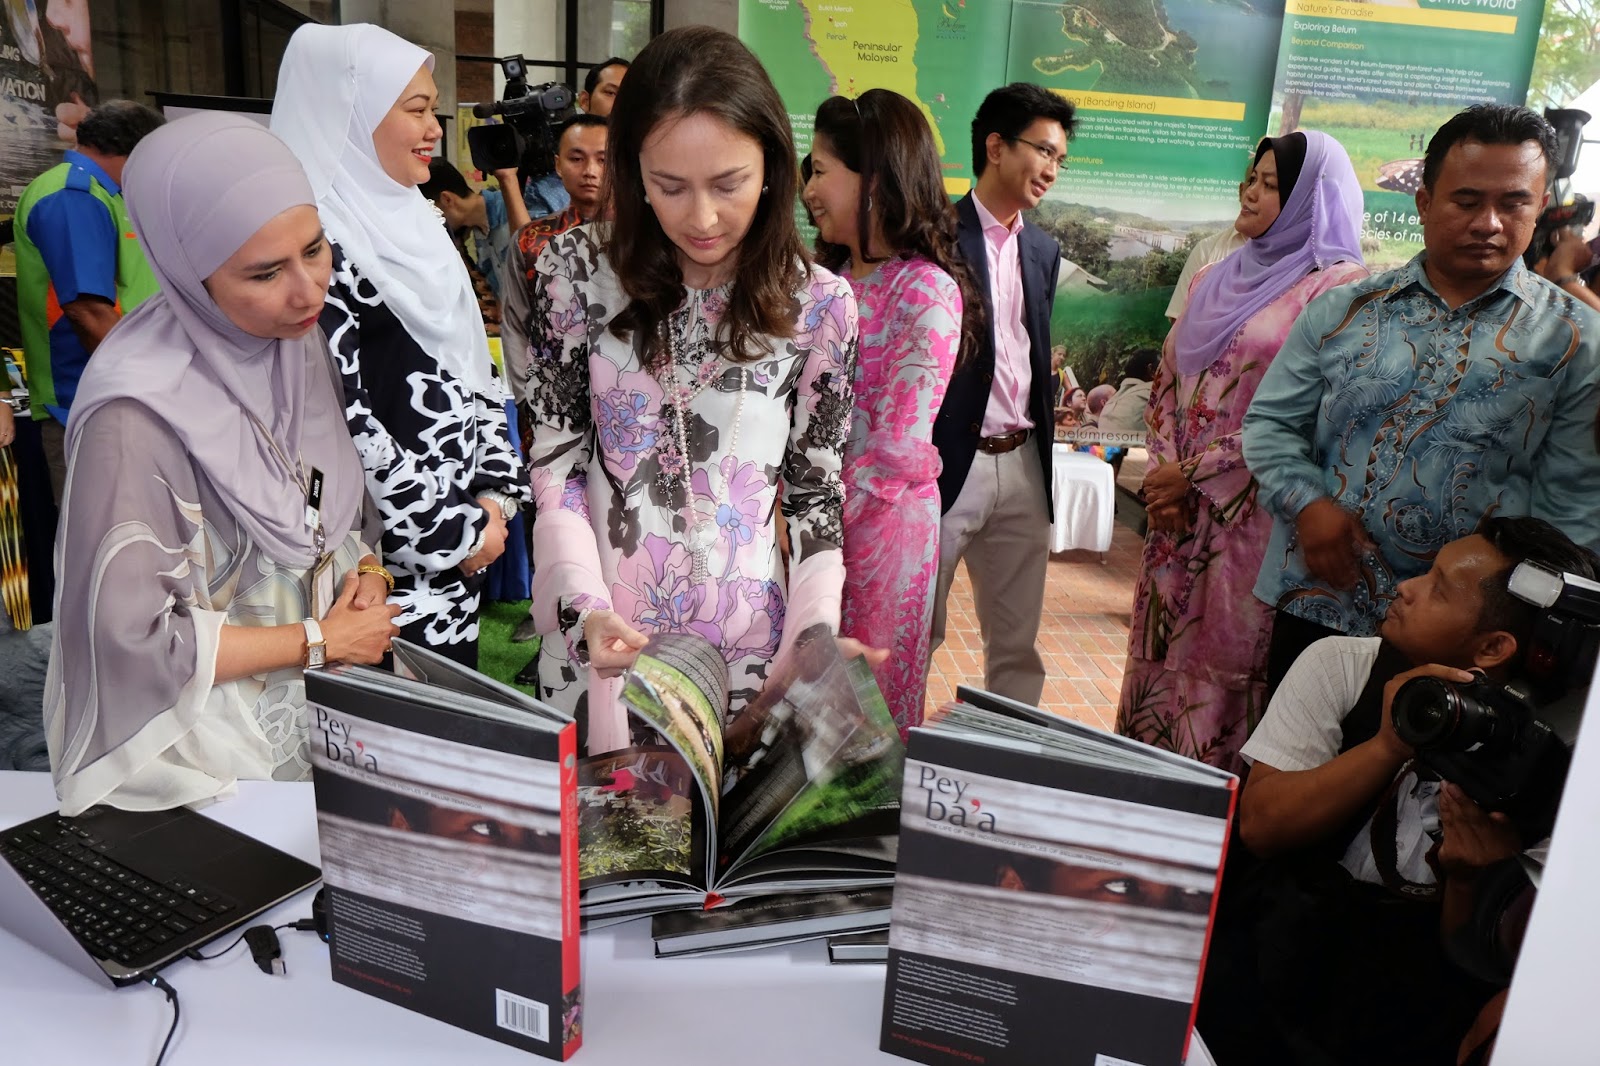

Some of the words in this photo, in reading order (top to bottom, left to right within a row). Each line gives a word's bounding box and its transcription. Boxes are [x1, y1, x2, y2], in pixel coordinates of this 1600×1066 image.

[1296, 2, 1333, 14] Nature's
[1335, 6, 1374, 18] Paradise
[1293, 20, 1330, 34] Exploring
[1332, 24, 1357, 35] Belum
[826, 32, 848, 41] Perak
[1291, 36, 1319, 46] Beyond
[1320, 39, 1365, 51] Comparison
[0, 45, 20, 61] ING
[853, 40, 903, 52] Peninsular
[857, 52, 898, 64] Malaysia
[1309, 54, 1318, 62] the
[1083, 96, 1125, 109] (Banding
[1126, 100, 1156, 112] Island)
[1374, 210, 1388, 223] of
[1392, 211, 1405, 224] 14
[1360, 227, 1391, 240] ecies
[1394, 229, 1407, 241] of
[1504, 684, 1525, 700] Canon
[316, 706, 352, 745] Pey
[325, 730, 379, 775] ba'a
[919, 765, 970, 804] Pey
[926, 788, 996, 834] ba'a
[939, 824, 952, 832] LIFE
[963, 830, 975, 838] THE
